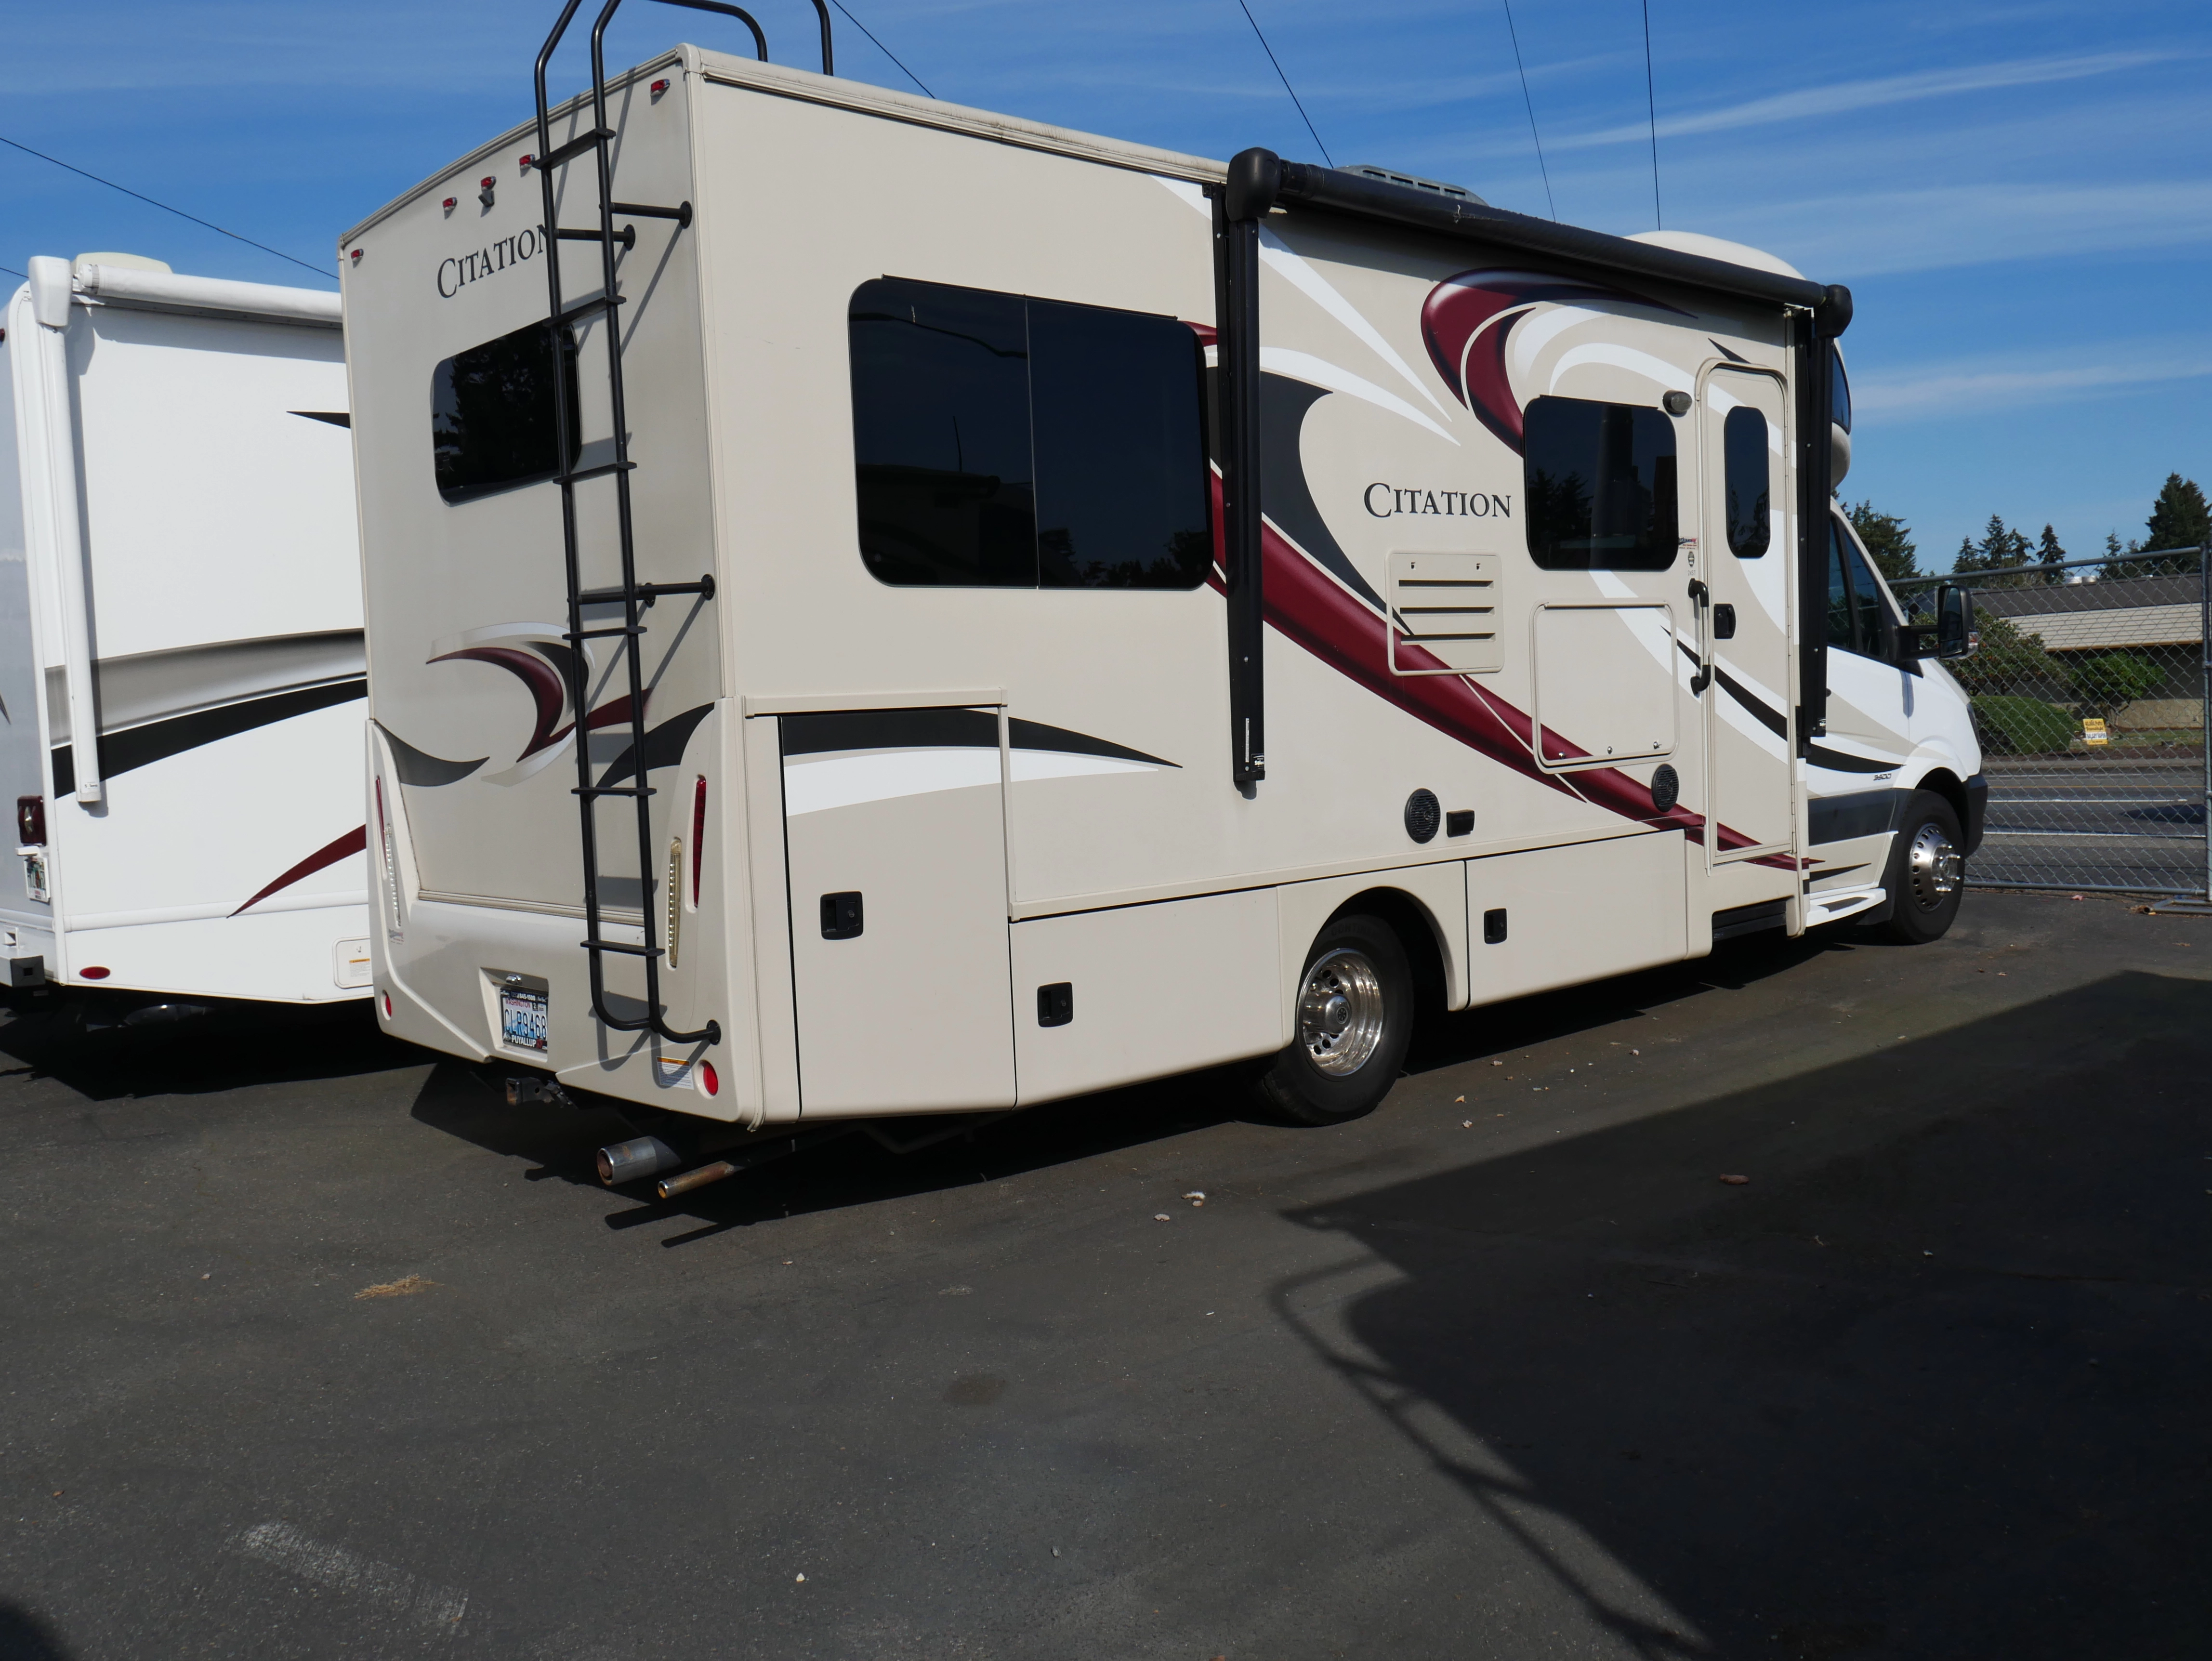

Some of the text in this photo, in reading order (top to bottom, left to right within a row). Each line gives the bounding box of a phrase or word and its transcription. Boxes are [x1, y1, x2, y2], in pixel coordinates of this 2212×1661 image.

[1364, 482, 1512, 518] CITATION
[505, 998, 531, 1009] WASHINGTON
[505, 1008, 547, 1041] CLR9468
[512, 1034, 536, 1047] PUYALLUP
